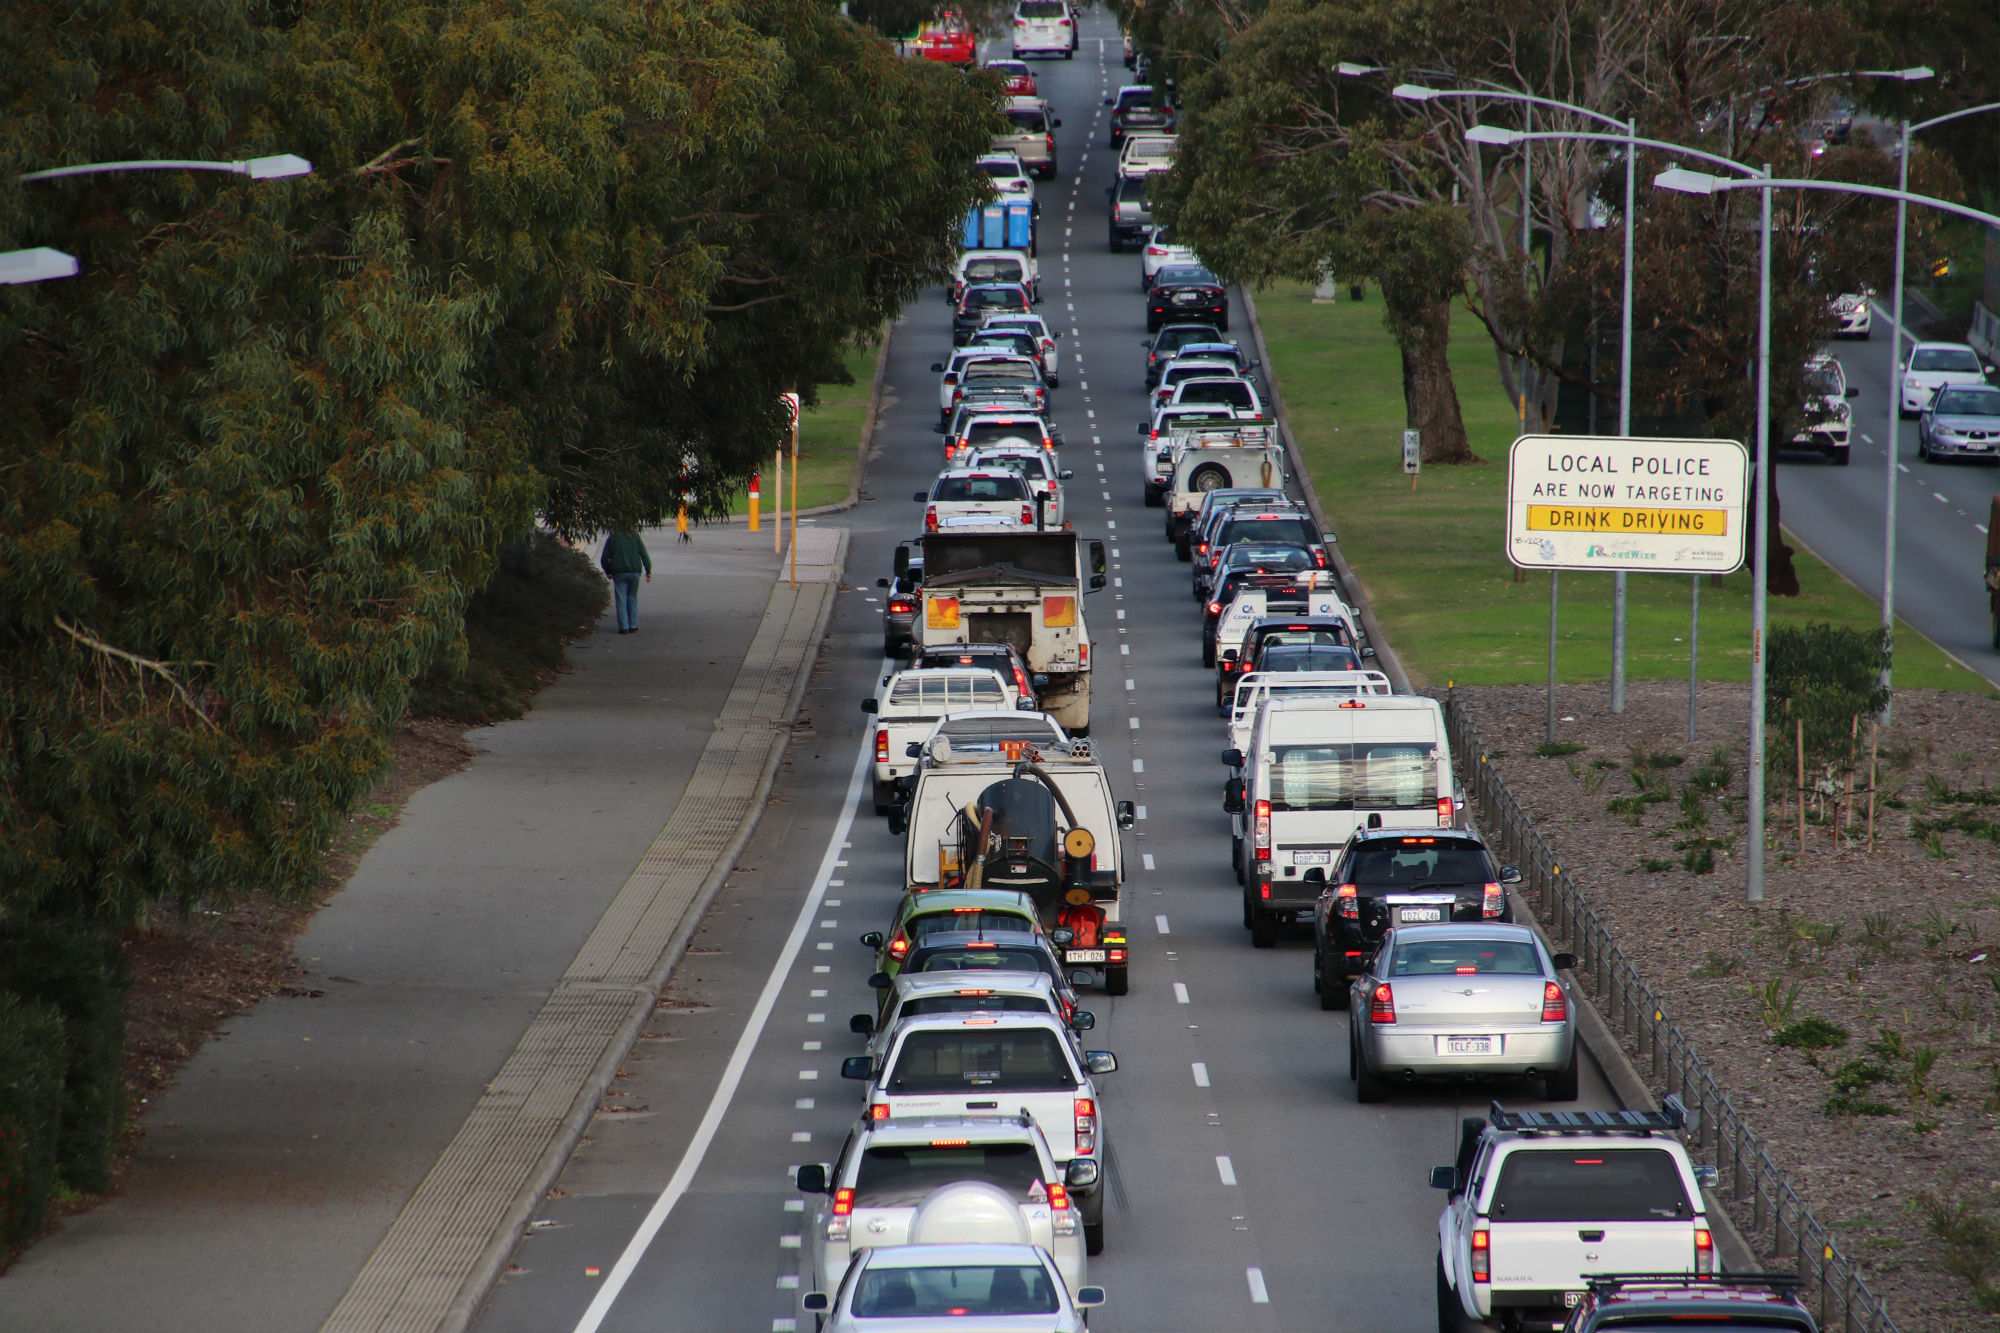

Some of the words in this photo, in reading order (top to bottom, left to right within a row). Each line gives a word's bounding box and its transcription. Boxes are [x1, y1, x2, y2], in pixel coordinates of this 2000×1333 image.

[1547, 454, 1618, 474] LOCAL
[1632, 456, 1711, 476] POLICE
[1533, 483, 1568, 498] ARE
[1579, 484, 1616, 499] NOW
[1626, 485, 1725, 502] TARGETING
[1550, 510, 1611, 528] DRINK
[1623, 512, 1705, 530] DRIVING
